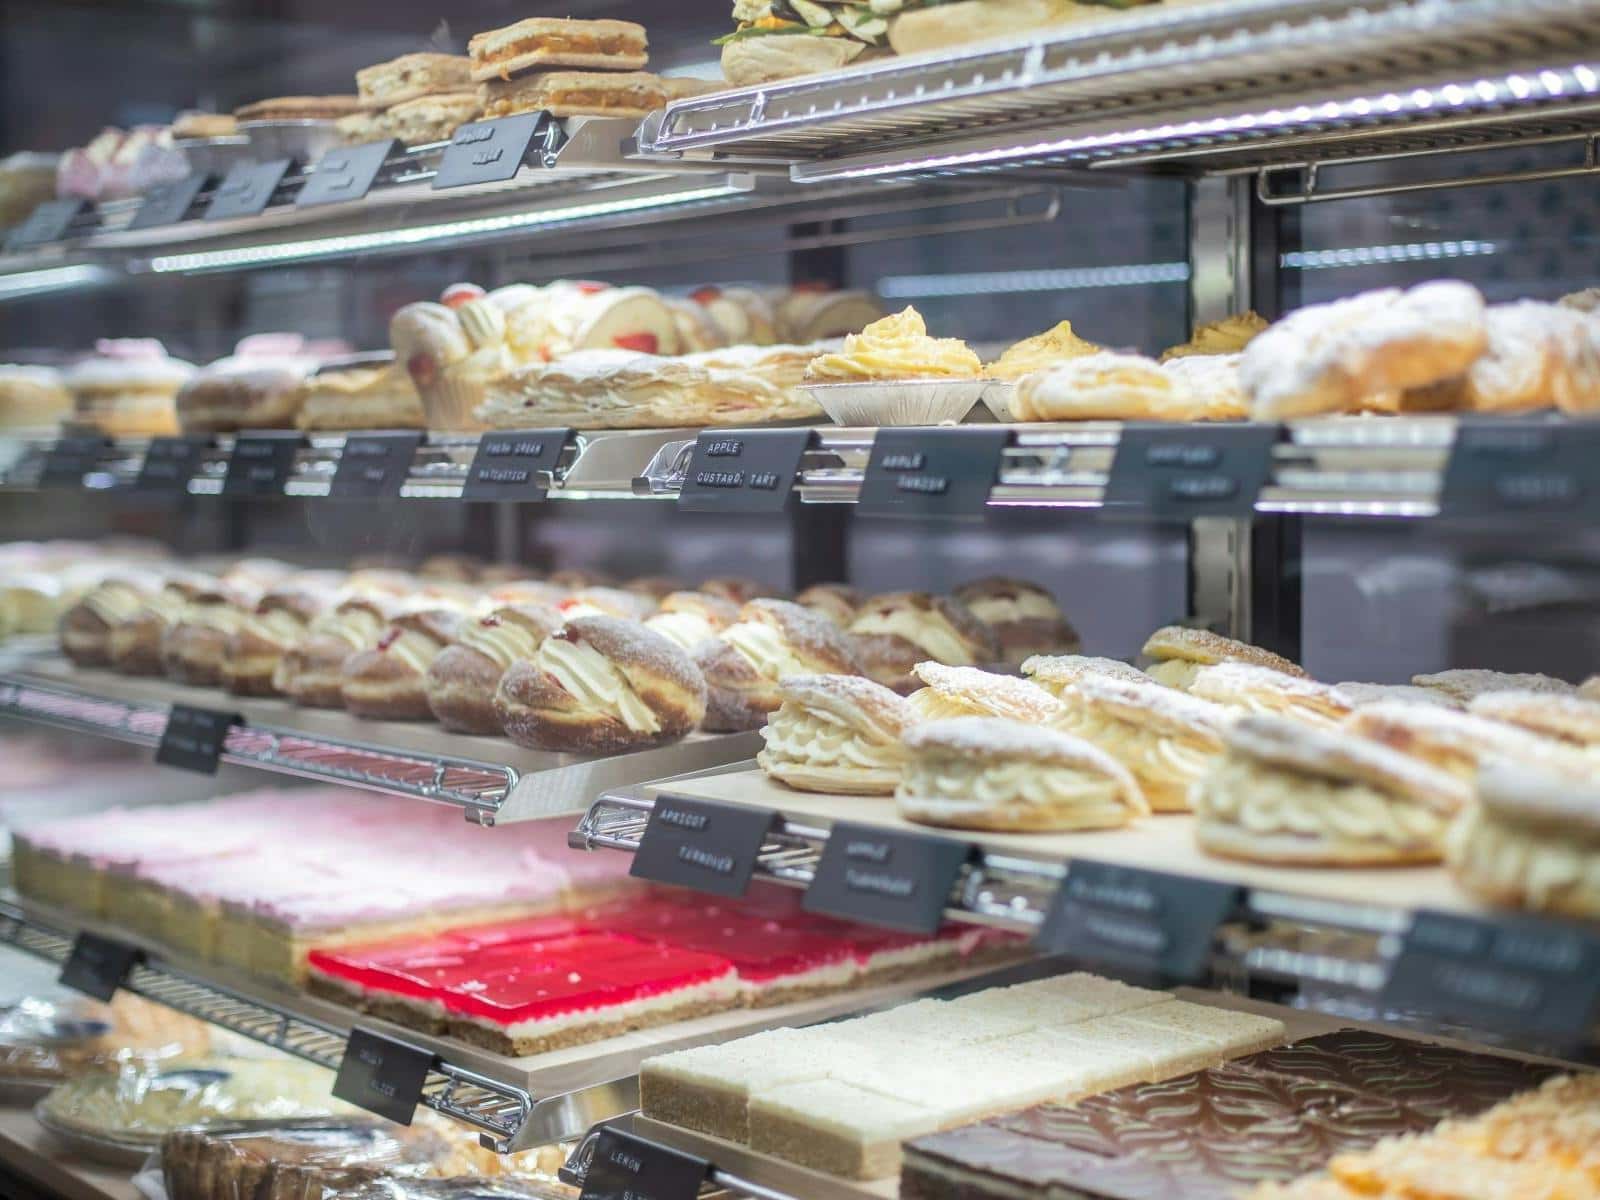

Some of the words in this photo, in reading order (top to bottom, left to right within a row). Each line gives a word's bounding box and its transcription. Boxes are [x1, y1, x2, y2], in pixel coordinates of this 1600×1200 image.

[708, 442, 739, 454] APPLE
[697, 472, 741, 485] CUSTARD
[750, 474, 776, 487] TART
[660, 808, 706, 828] APRICOT
[611, 1152, 640, 1173] LEMON
